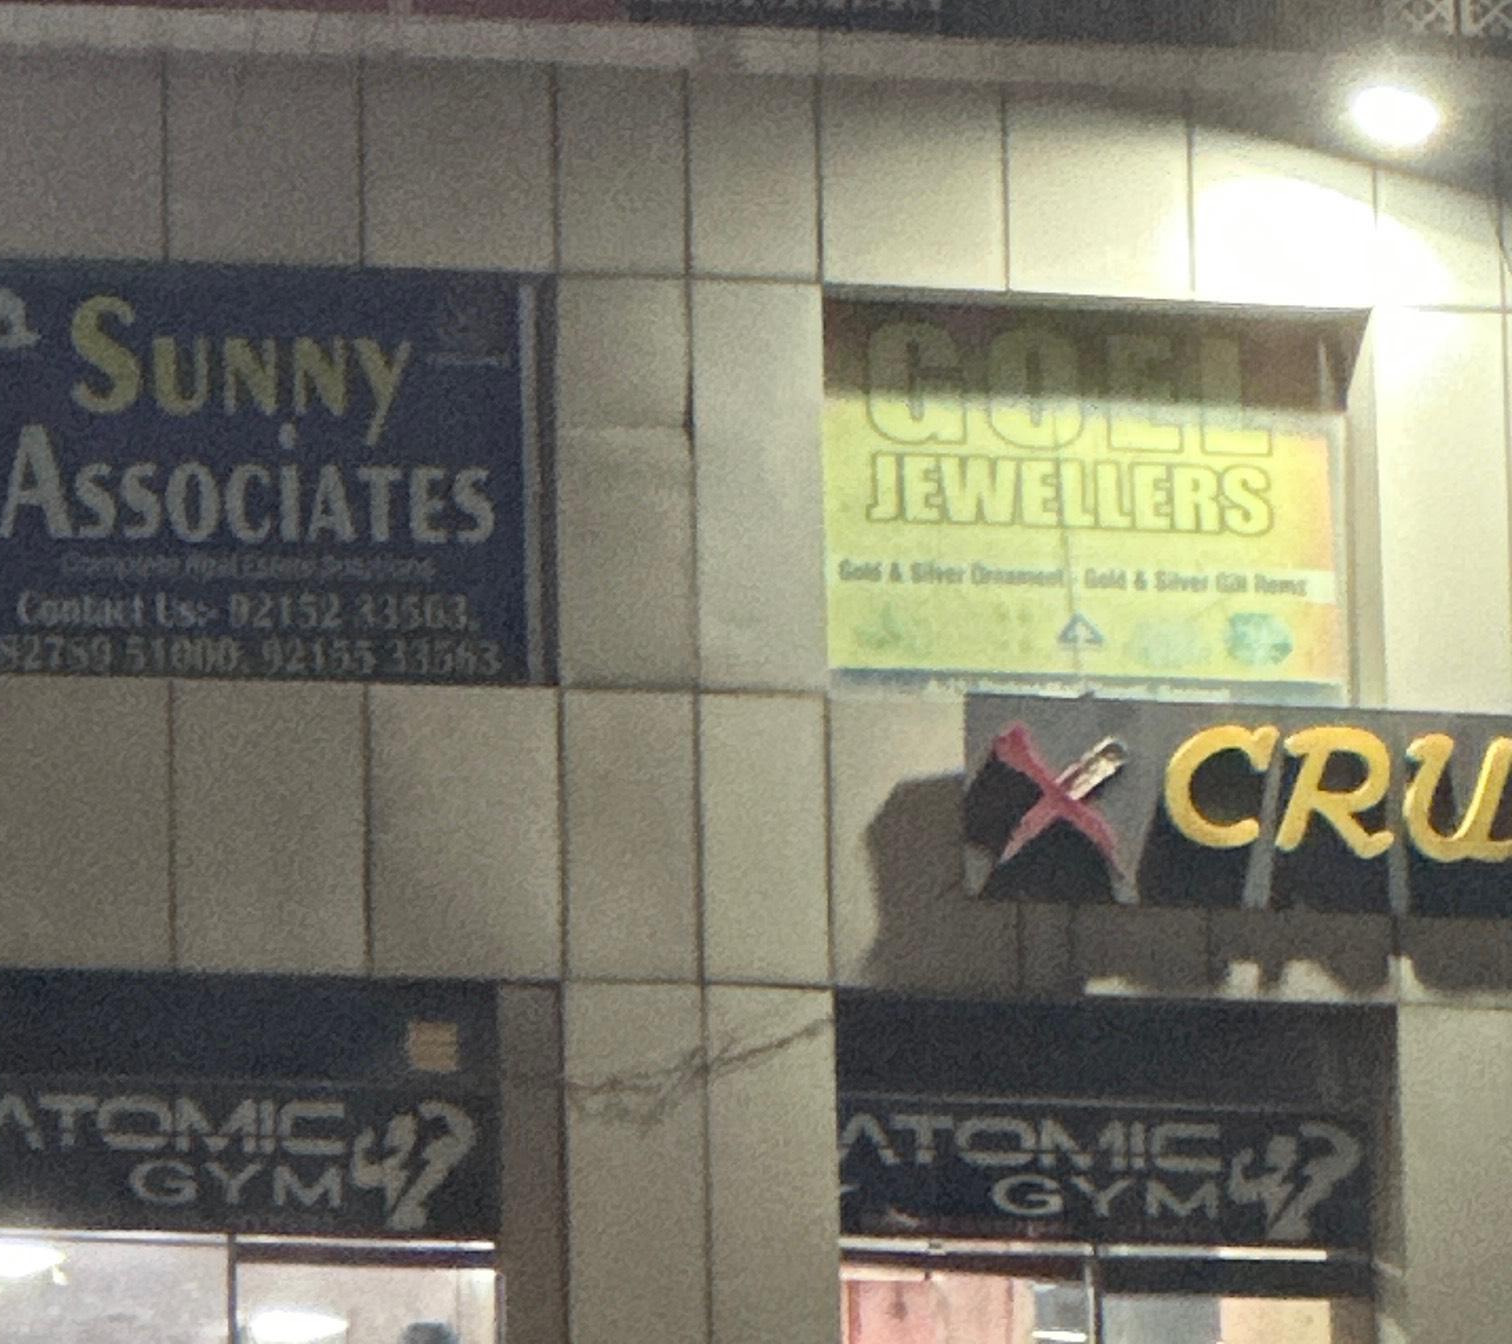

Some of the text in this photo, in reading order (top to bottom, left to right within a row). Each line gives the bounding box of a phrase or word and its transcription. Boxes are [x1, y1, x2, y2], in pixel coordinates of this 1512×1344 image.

[866, 320, 1274, 456] GOEL
[866, 451, 1274, 538] JEWELLERS
[838, 1115, 1224, 1173] ATOMIC
[128, 1158, 345, 1209] GYM
[992, 1173, 1220, 1220] GYM
